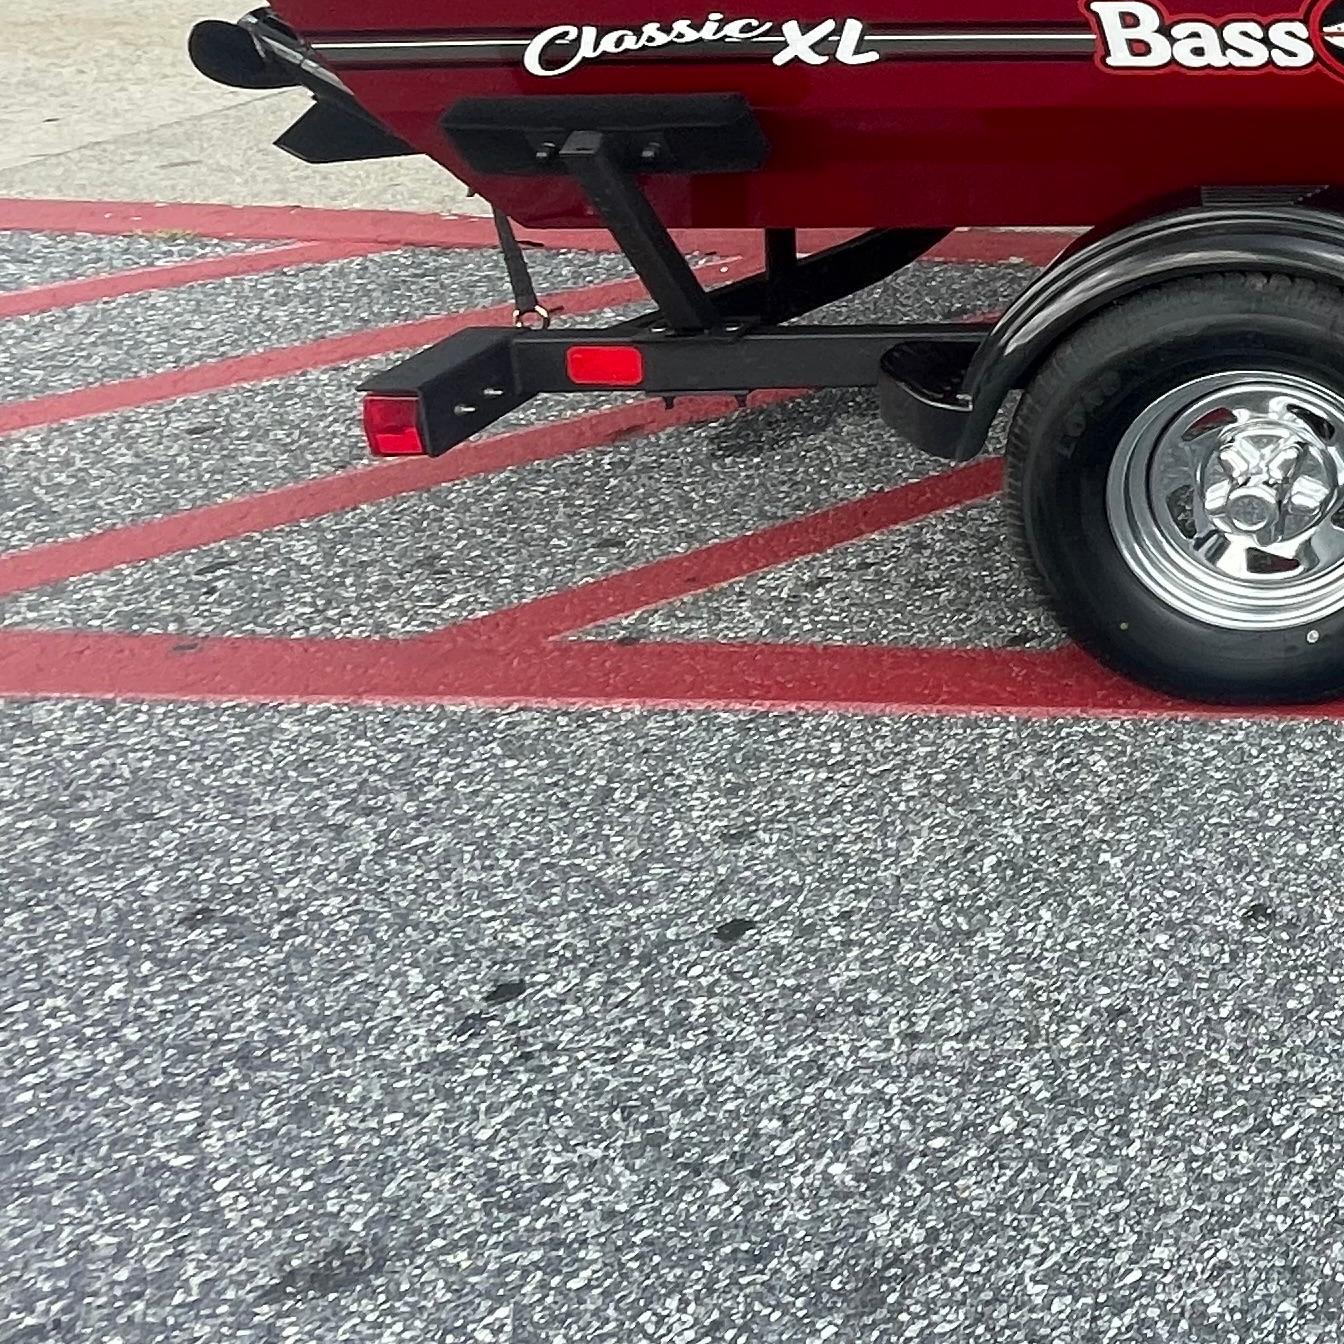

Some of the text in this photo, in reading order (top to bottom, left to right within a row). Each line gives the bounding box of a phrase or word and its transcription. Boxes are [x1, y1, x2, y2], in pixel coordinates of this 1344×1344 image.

[524, 12, 880, 76] Classic XL
[1090, 0, 1315, 67] Bass
